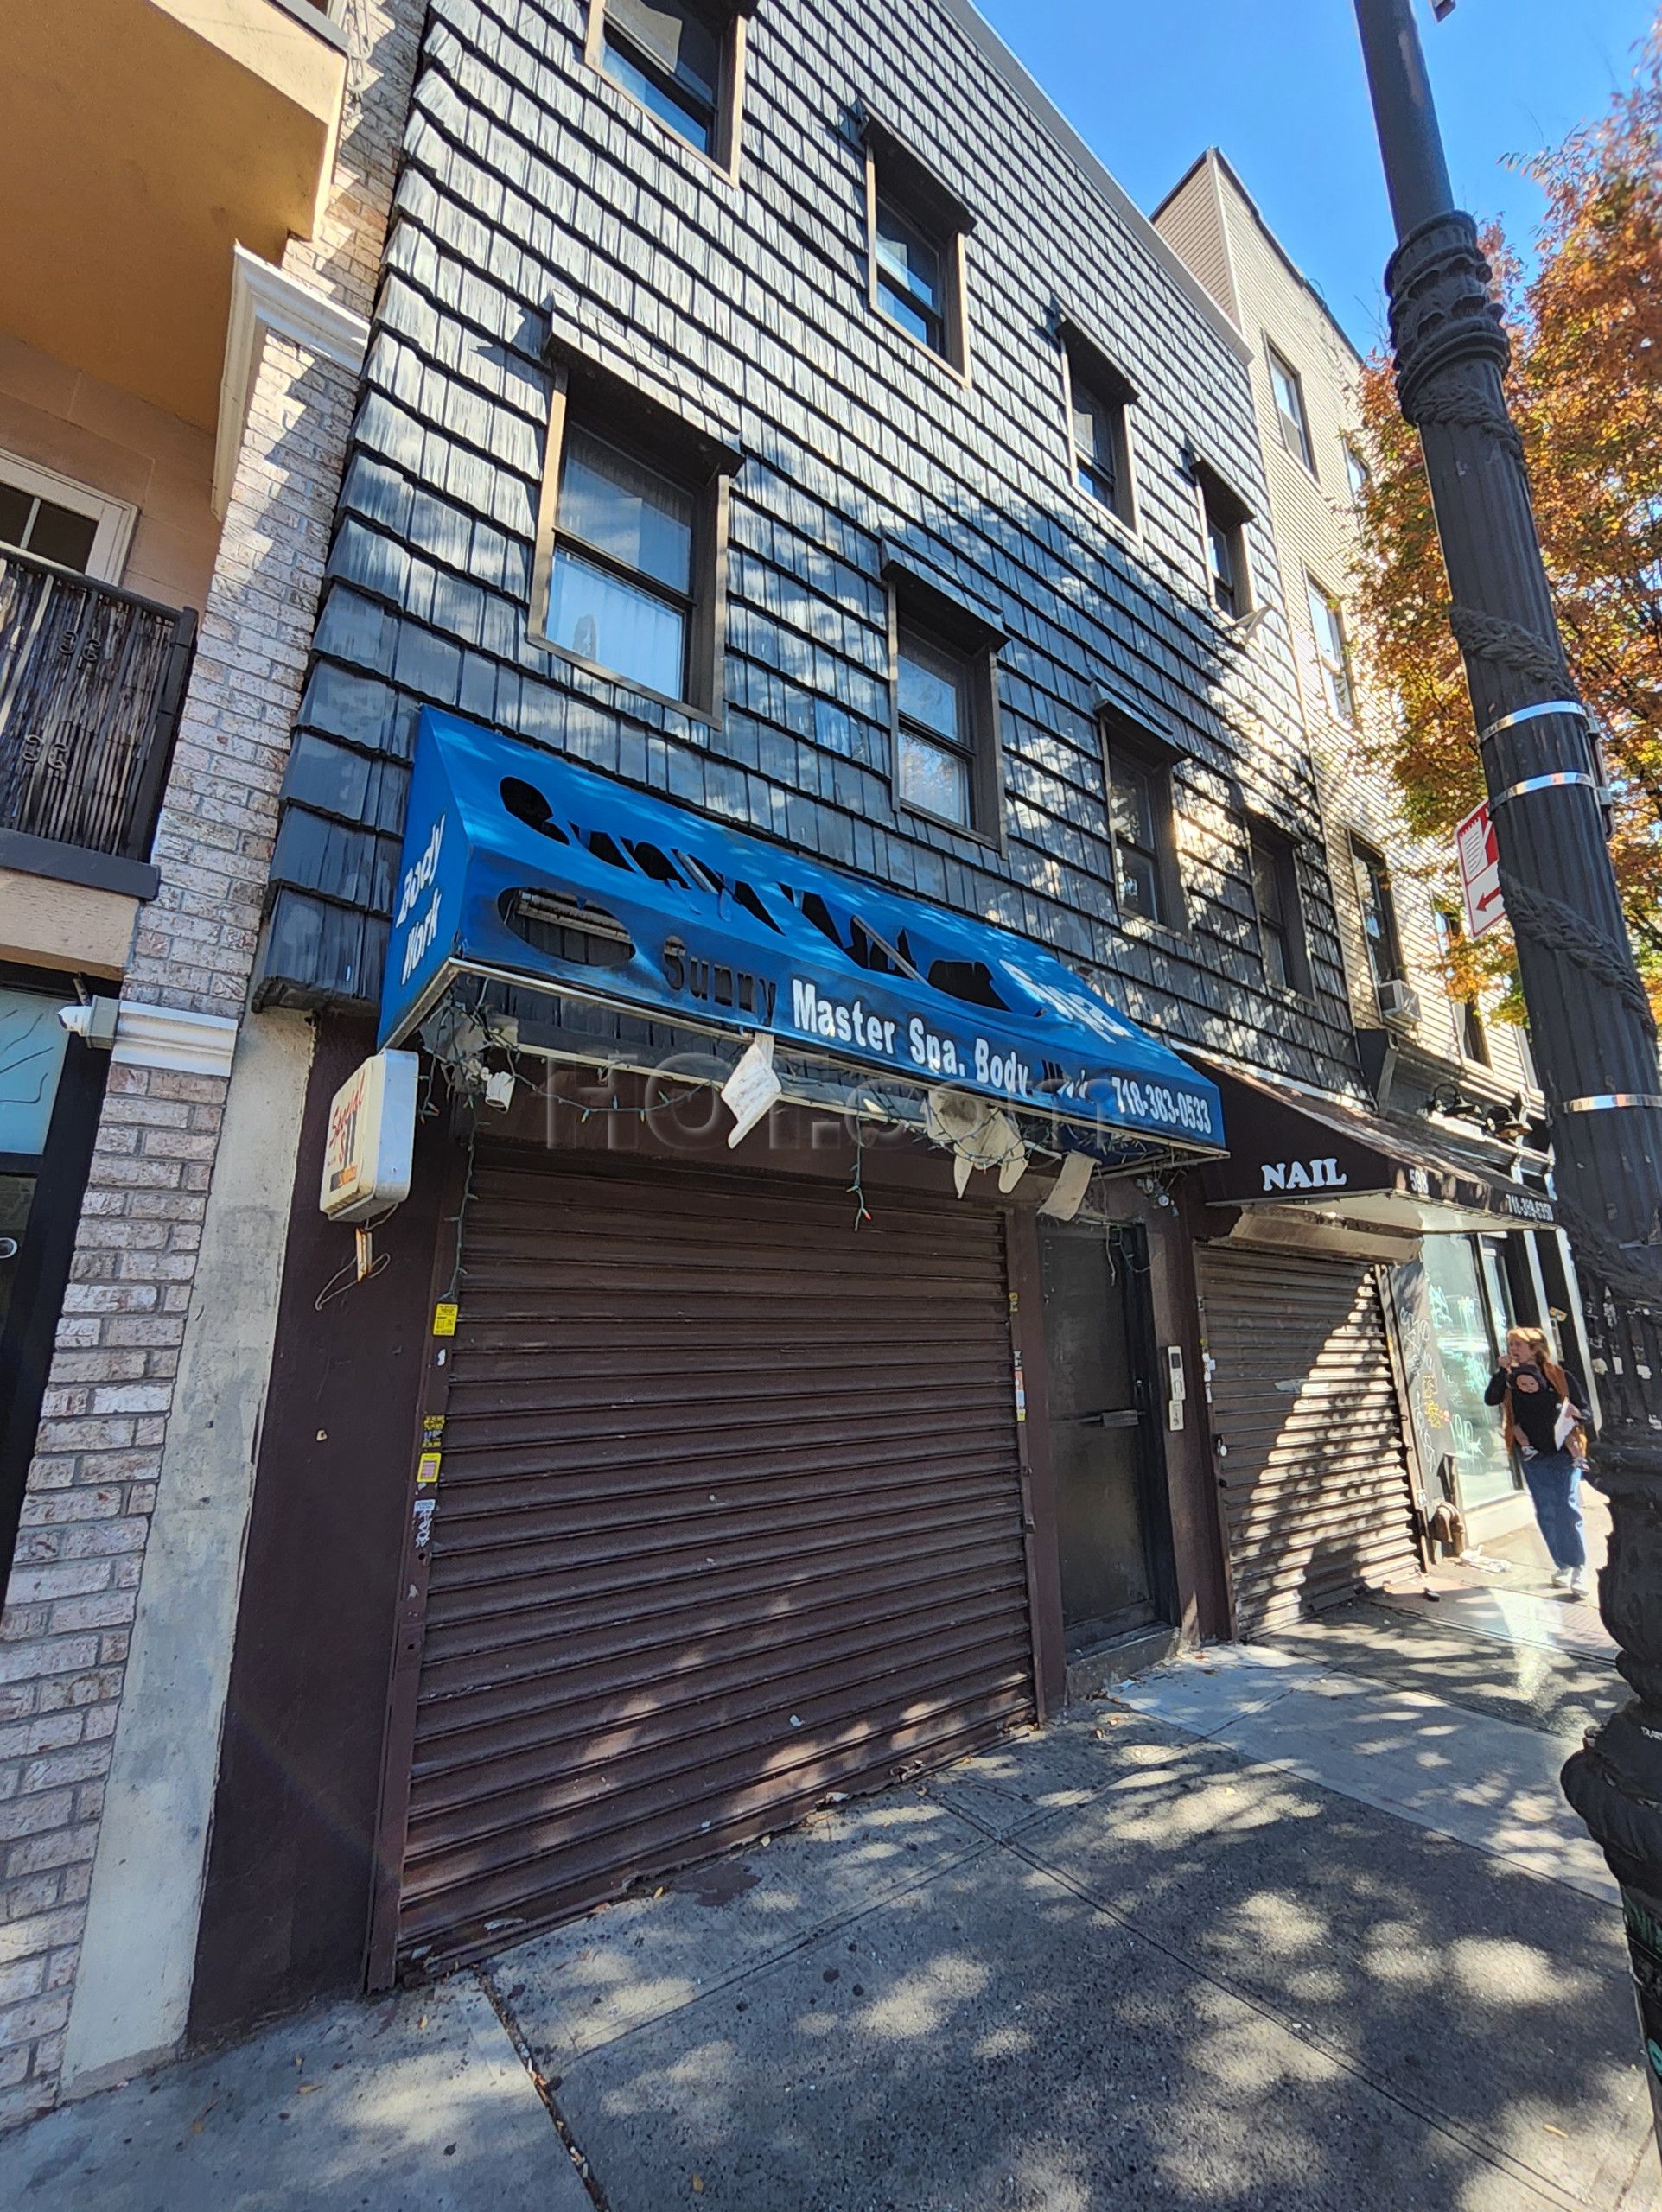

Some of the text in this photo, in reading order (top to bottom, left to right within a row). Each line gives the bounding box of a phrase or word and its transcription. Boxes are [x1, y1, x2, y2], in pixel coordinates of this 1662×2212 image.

[395, 814, 446, 929] Body
[402, 887, 442, 986] Work
[663, 935, 777, 1028] Sunny
[792, 979, 895, 1055] Master
[909, 1017, 966, 1077] Spa.
[975, 1039, 1029, 1098] Body
[1111, 1077, 1211, 1134] 718-383-0533
[1262, 1158, 1347, 1192] NAIL
[1409, 1168, 1429, 1194] 598
